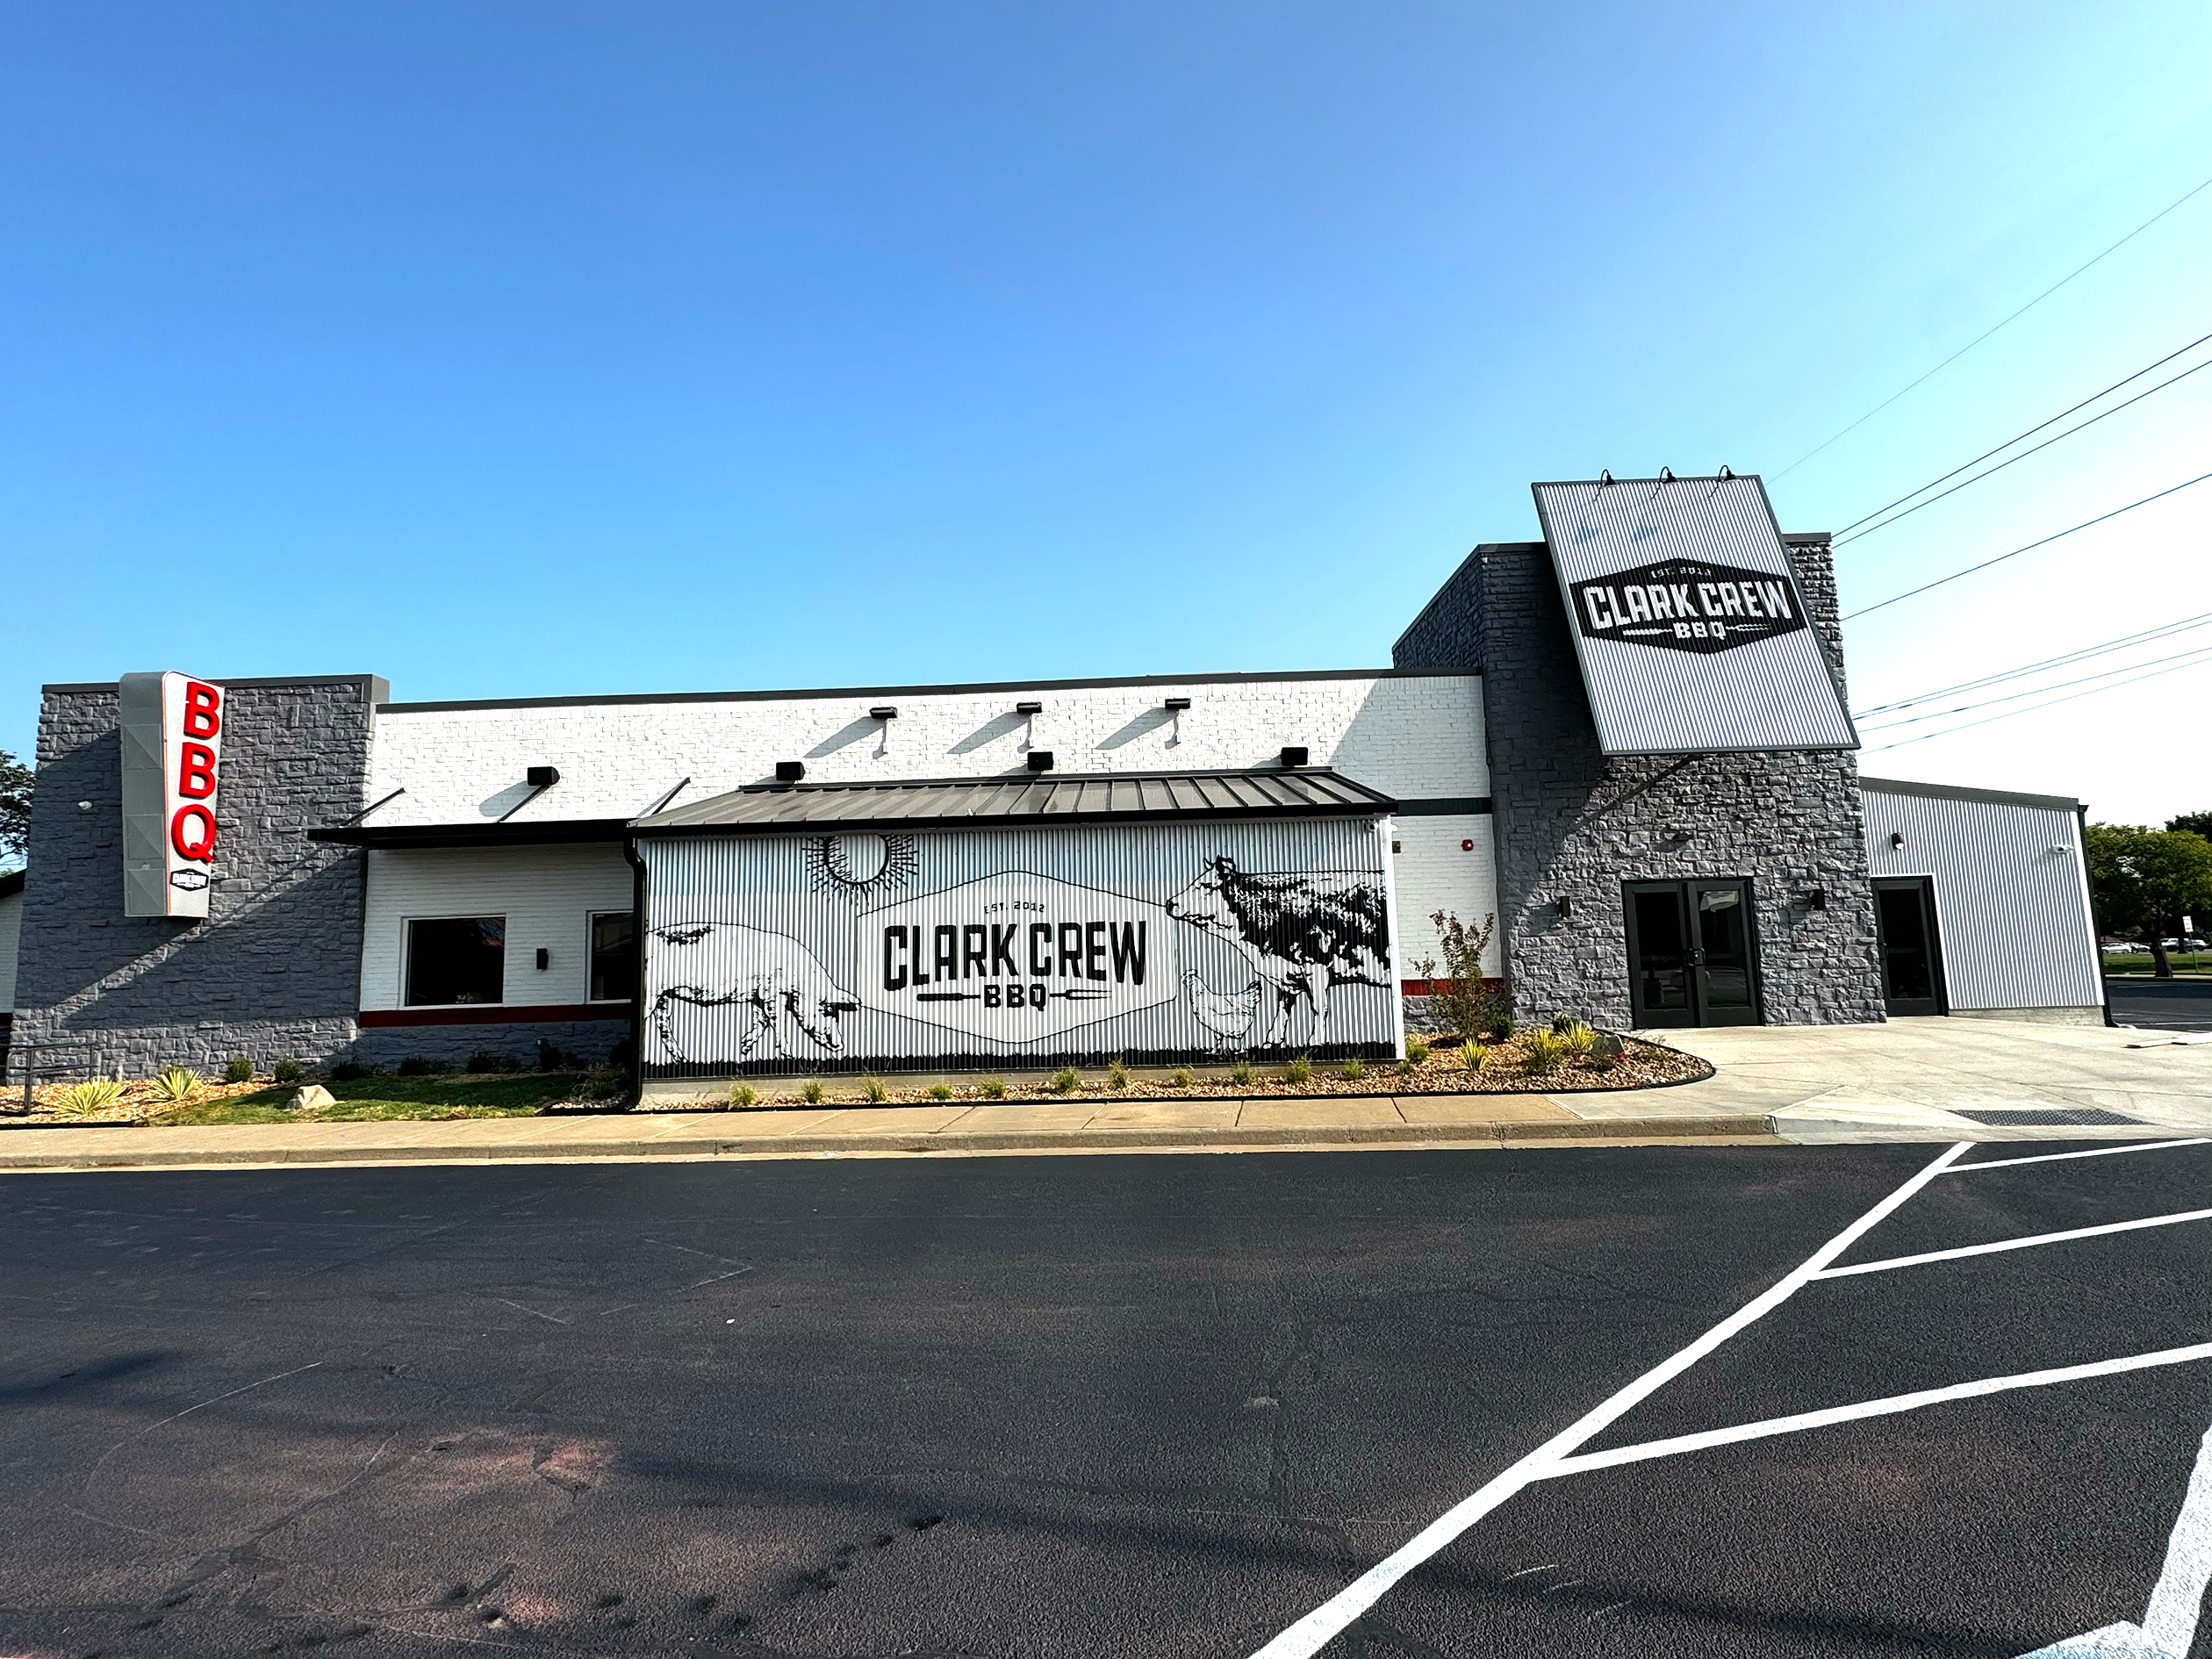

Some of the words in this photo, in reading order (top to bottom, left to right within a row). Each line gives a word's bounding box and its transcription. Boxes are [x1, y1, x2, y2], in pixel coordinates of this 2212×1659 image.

[1583, 584, 1700, 630] CLARK
[1698, 580, 1792, 620] CREW
[1672, 621, 1727, 641] BBQ
[170, 680, 220, 864] BBQ
[984, 901, 1009, 915] EST.
[884, 923, 1018, 992] CLARK
[1029, 921, 1146, 986] CREW
[983, 983, 1046, 1012] BBQ
